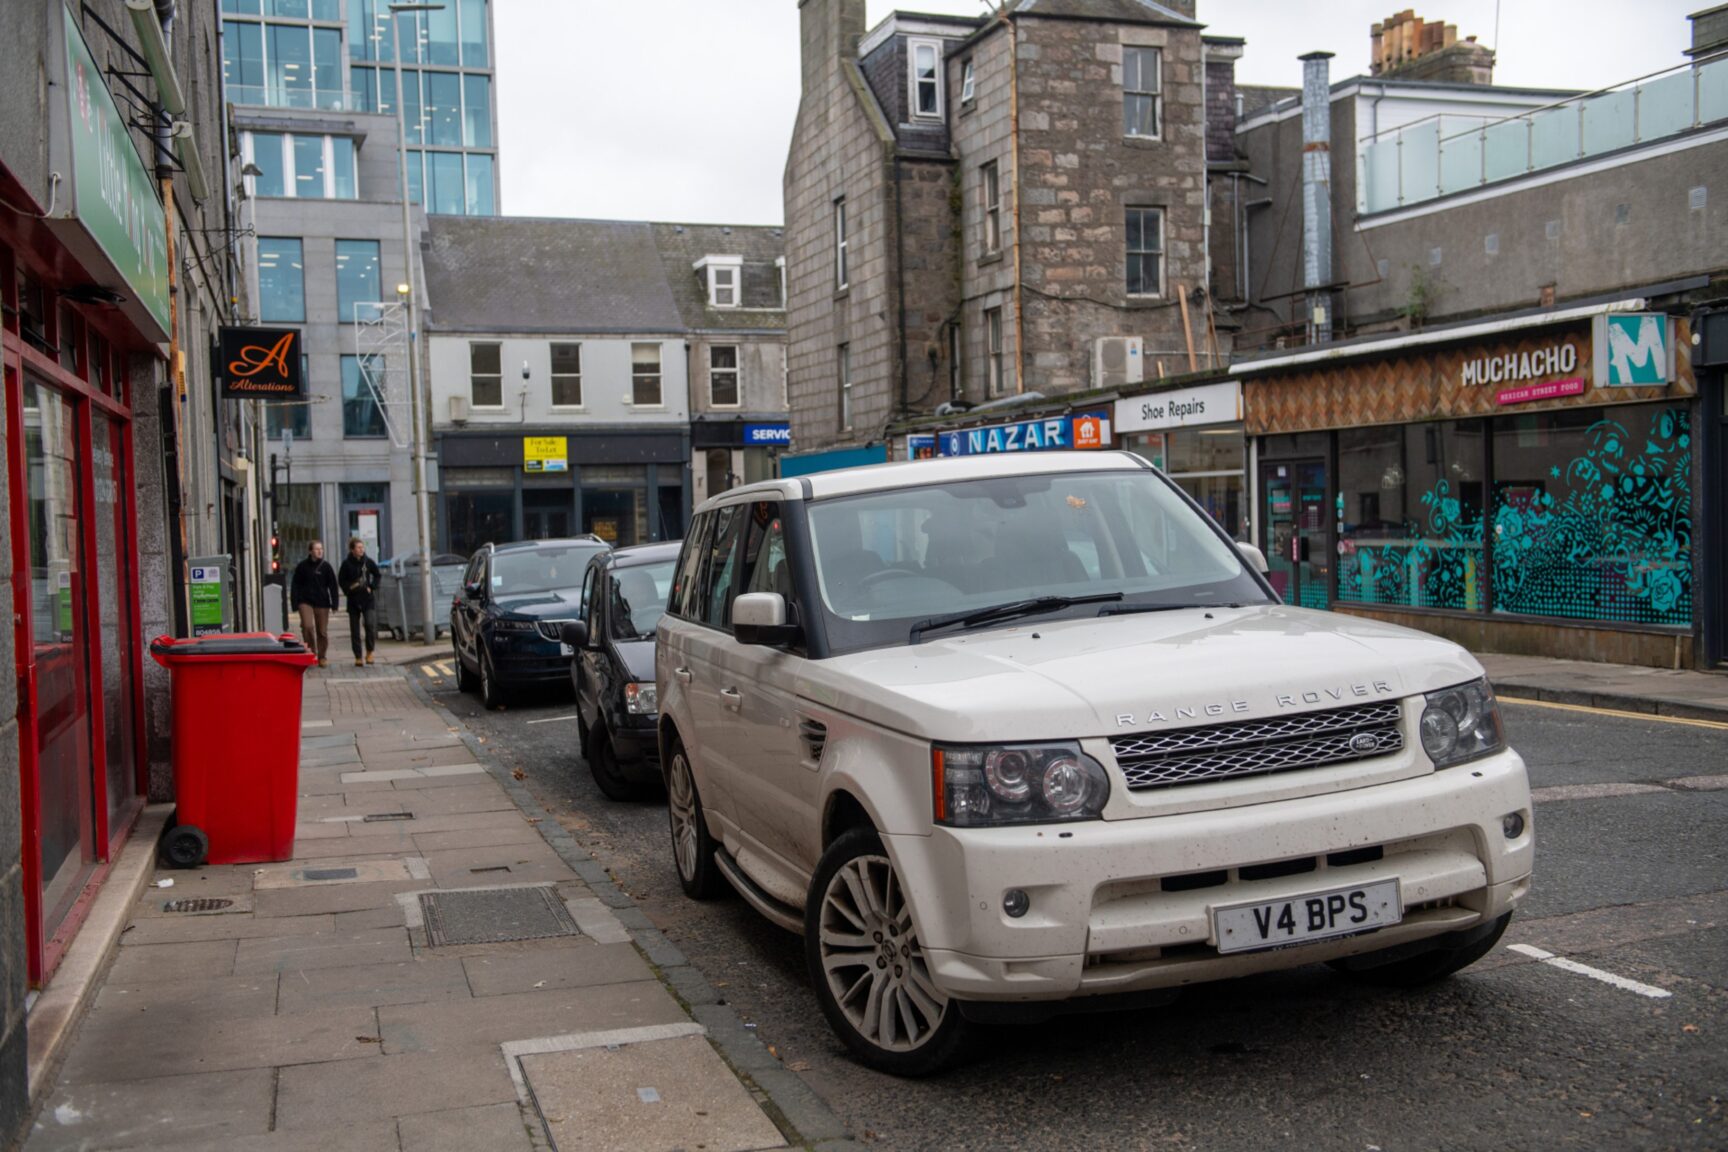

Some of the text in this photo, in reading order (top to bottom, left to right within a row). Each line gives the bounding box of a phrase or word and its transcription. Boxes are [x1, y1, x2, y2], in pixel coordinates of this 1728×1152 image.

[229, 332, 294, 378] A
[1461, 343, 1577, 386] MUCHACHO
[1609, 315, 1666, 384] M
[229, 379, 295, 392] Alterations
[1532, 385, 1557, 396] STREET
[1560, 382, 1579, 392] FOOD
[1142, 397, 1205, 420] Shoe Repairs
[967, 420, 1063, 453] NAZAR
[194, 569, 202, 578] P
[1115, 680, 1393, 728] RANGE ROVER
[1253, 890, 1369, 939] V4 BPS
